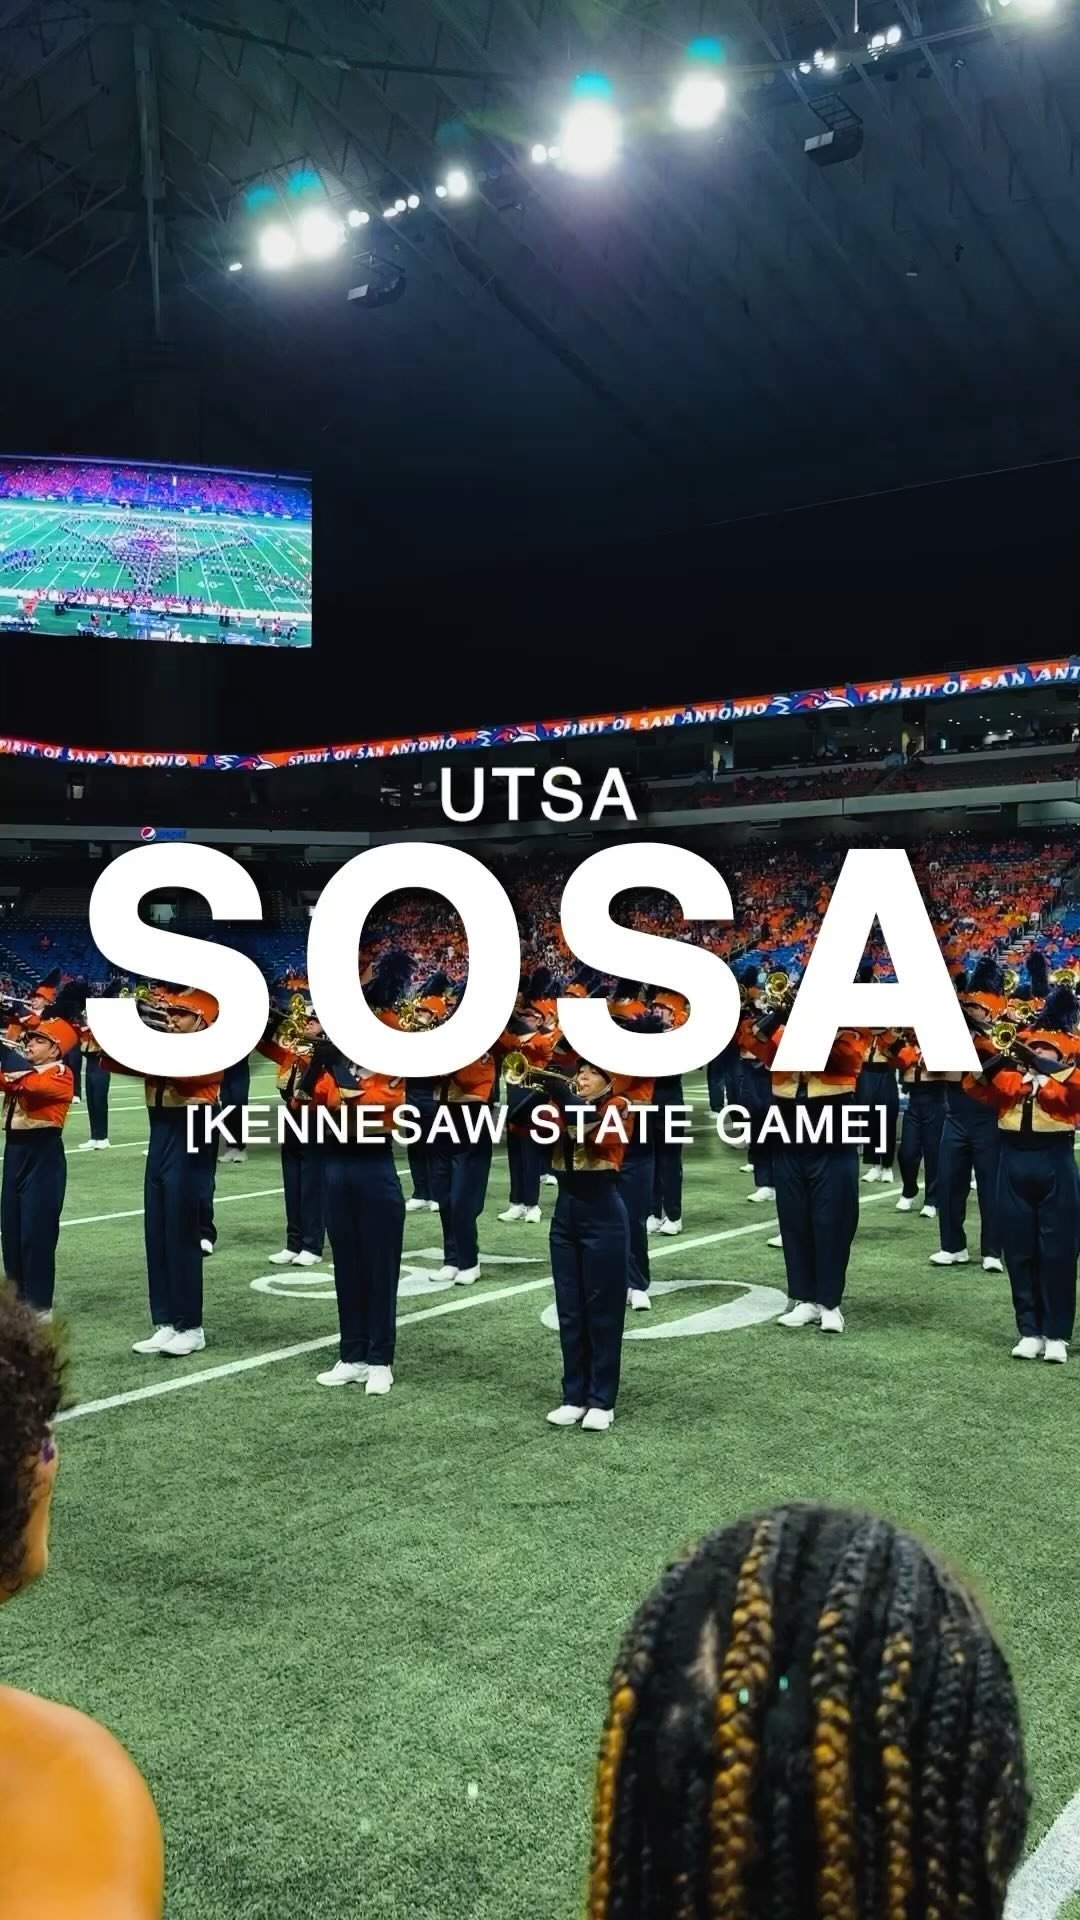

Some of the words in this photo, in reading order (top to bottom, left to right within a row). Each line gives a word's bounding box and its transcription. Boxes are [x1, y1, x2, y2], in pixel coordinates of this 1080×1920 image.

[867, 683, 935, 703] SPIRIT
[942, 678, 972, 695] OF
[979, 671, 1027, 690] SAN
[552, 720, 608, 738] SPIRIT
[612, 717, 634, 731] OF
[639, 713, 677, 729] SAN
[681, 703, 768, 725] ANTONIO
[43, 746, 64, 760] OF
[67, 748, 99, 765] SAN
[105, 751, 188, 768] ANTONIO
[287, 752, 330, 767] SPIRIT
[334, 749, 352, 761] OF
[356, 746, 385, 760] SAN
[389, 737, 457, 757] ANTONIO
